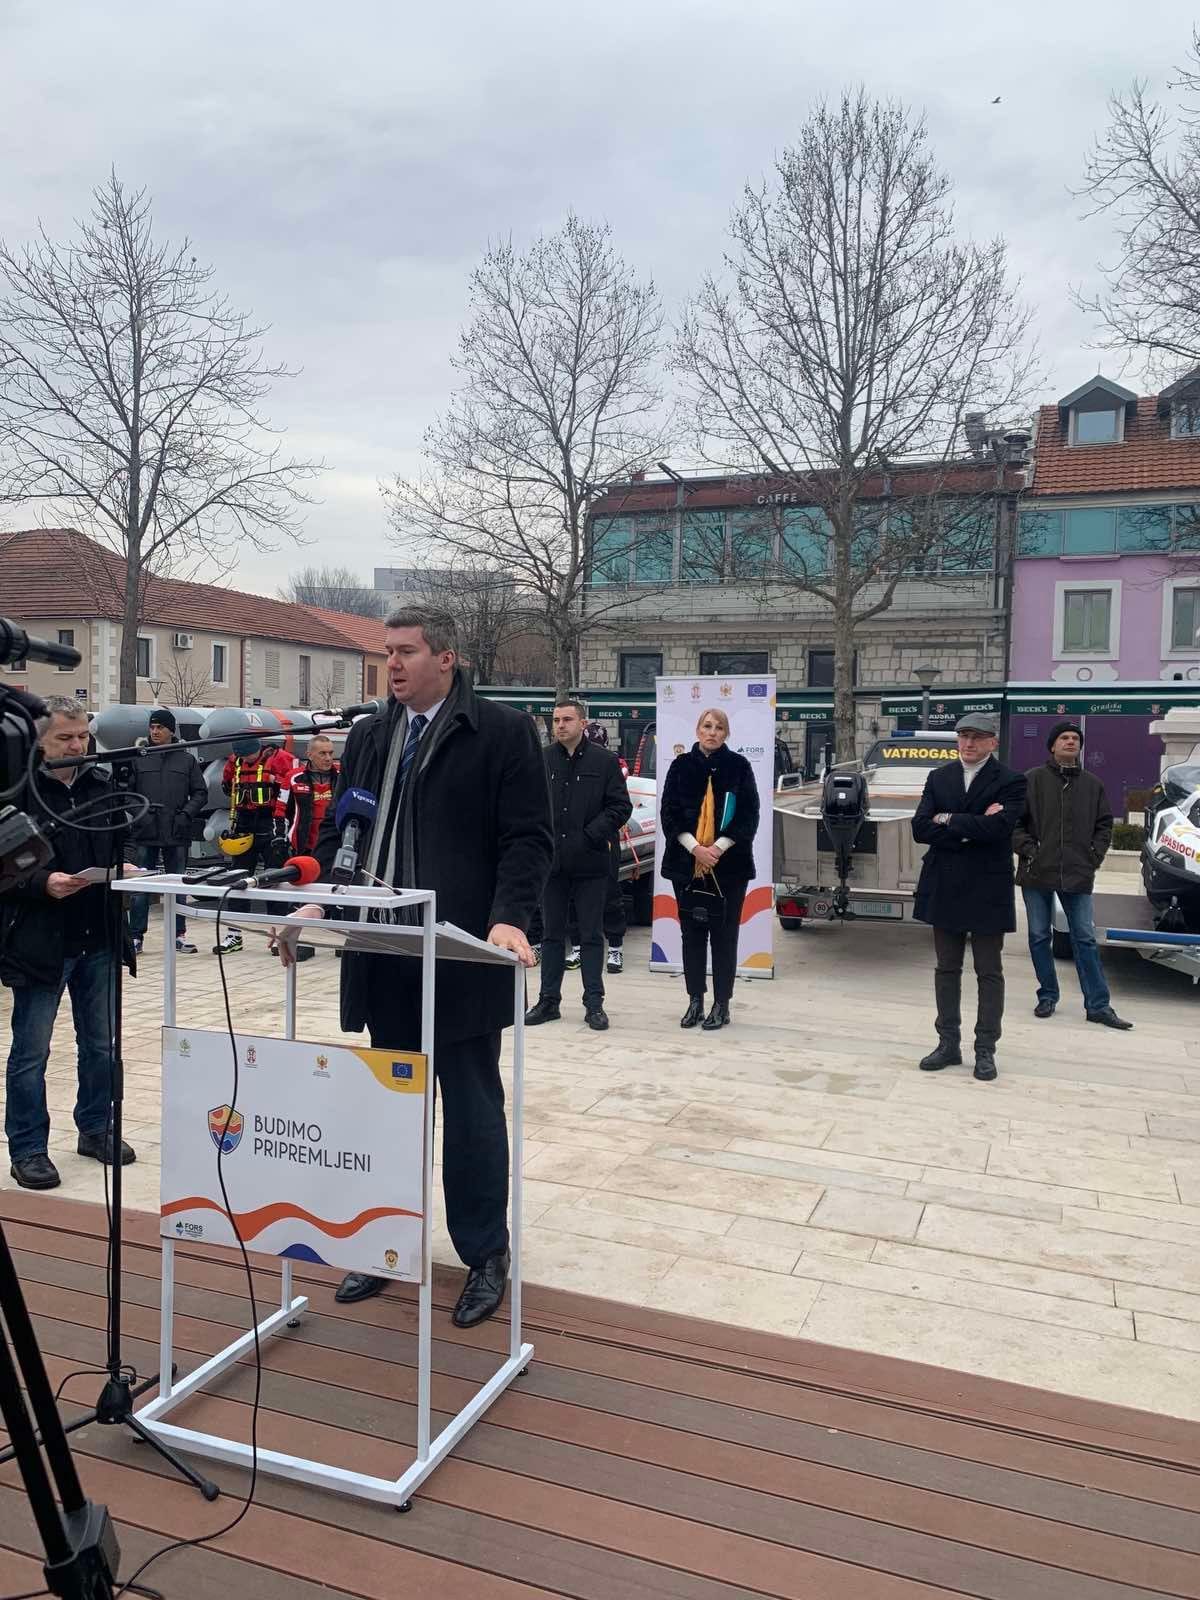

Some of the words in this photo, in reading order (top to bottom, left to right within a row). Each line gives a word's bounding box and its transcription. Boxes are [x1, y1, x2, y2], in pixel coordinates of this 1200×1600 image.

[882, 748, 961, 760] VATROGAS
[1160, 834, 1196, 858] SPASIOCI
[254, 1115, 322, 1142] BUDIMO
[254, 1138, 371, 1172] PRIPREMLJENI
[184, 1223, 203, 1232] FORS
